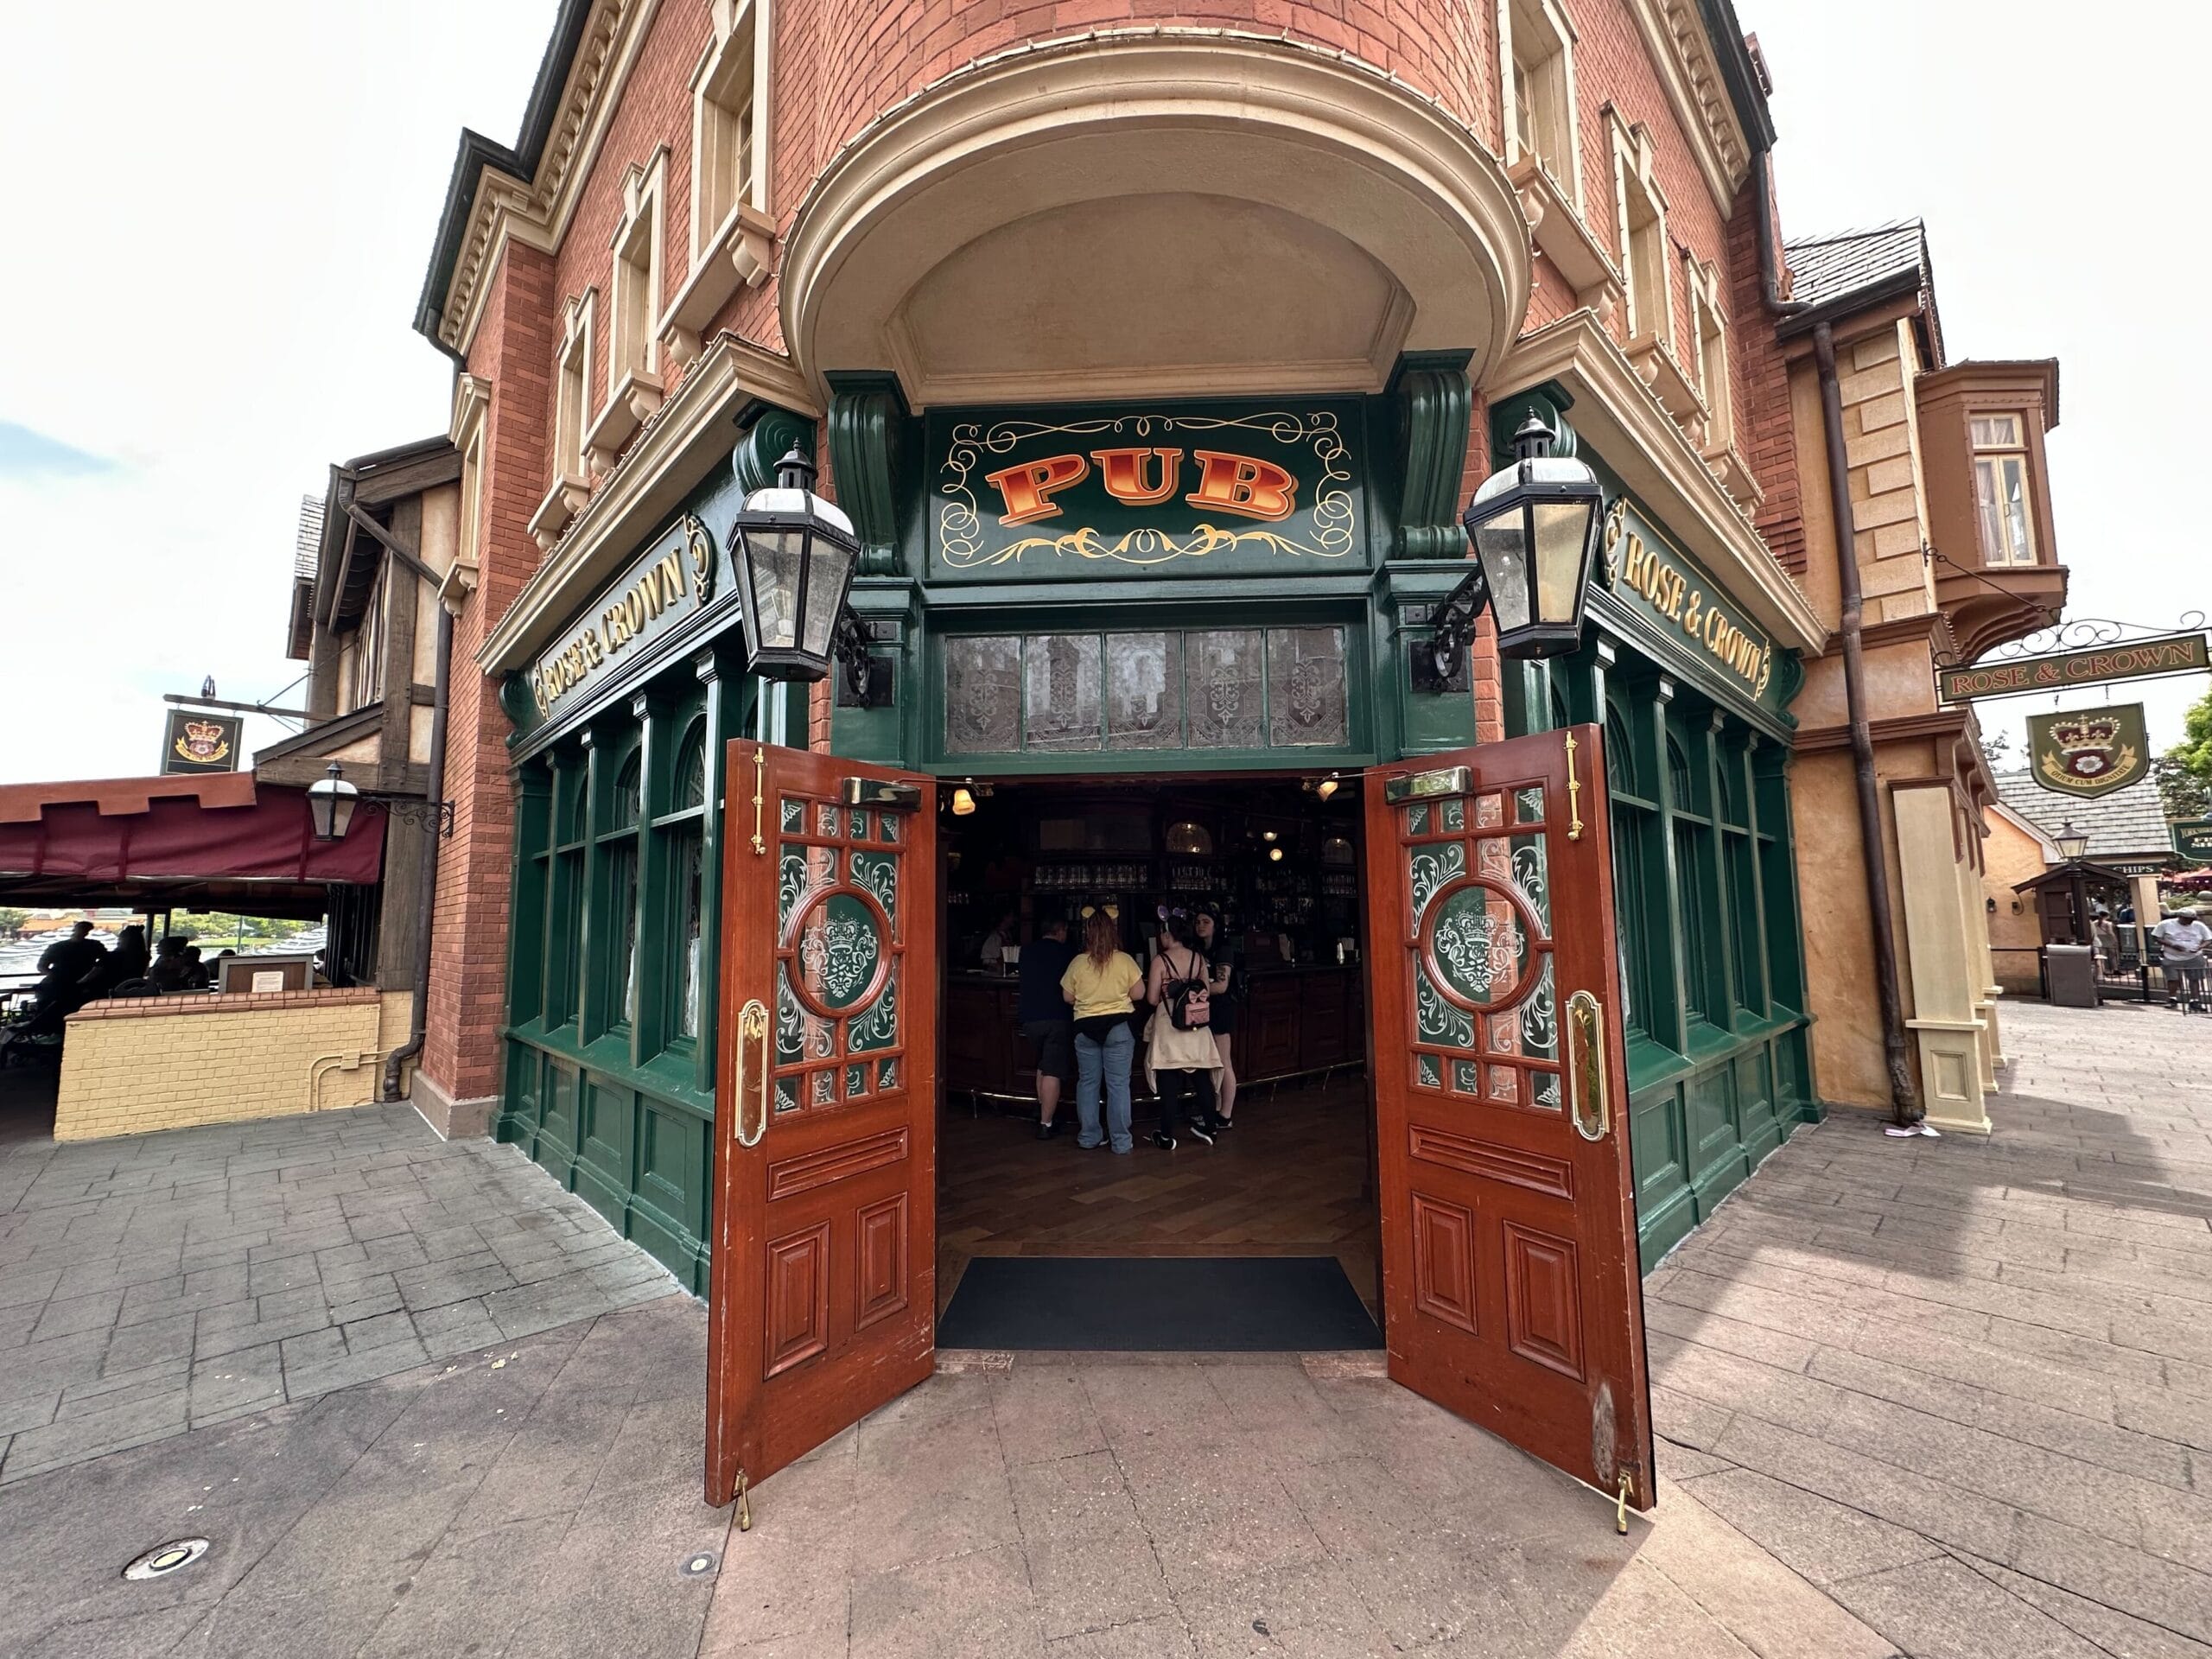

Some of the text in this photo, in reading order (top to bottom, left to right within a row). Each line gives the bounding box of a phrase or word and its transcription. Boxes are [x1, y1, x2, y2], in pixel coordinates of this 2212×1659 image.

[985, 447, 1299, 528] PUB
[544, 545, 687, 702] ROSE & CROWN
[1623, 531, 1763, 683] ROSE & CROWN
[1951, 641, 2195, 695] ROSE & CROWN
[2050, 770, 2074, 784] OTIUM
